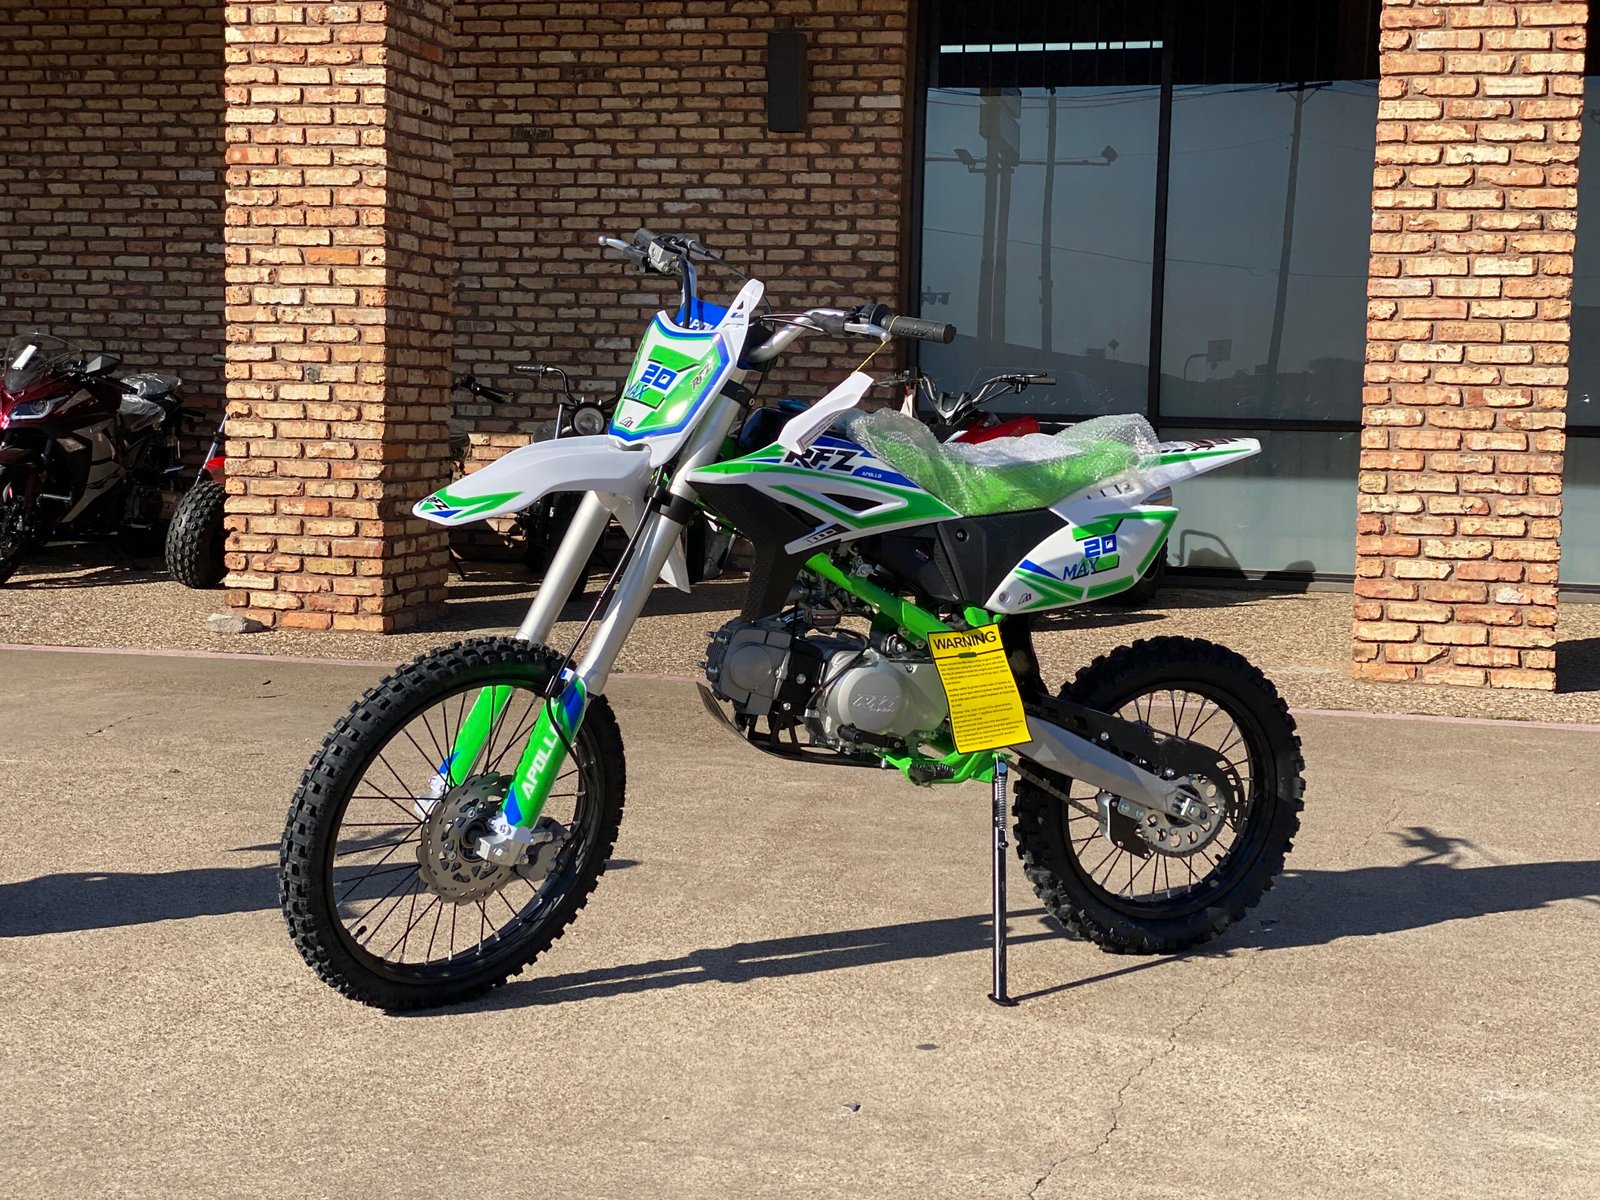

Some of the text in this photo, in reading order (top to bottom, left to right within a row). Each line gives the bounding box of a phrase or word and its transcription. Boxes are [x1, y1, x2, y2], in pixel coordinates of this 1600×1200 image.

[639, 363, 678, 391] 20
[784, 448, 858, 472] RFZ
[1083, 534, 1117, 559] 20
[1062, 557, 1099, 581] MAX
[933, 631, 997, 650] WARNING
